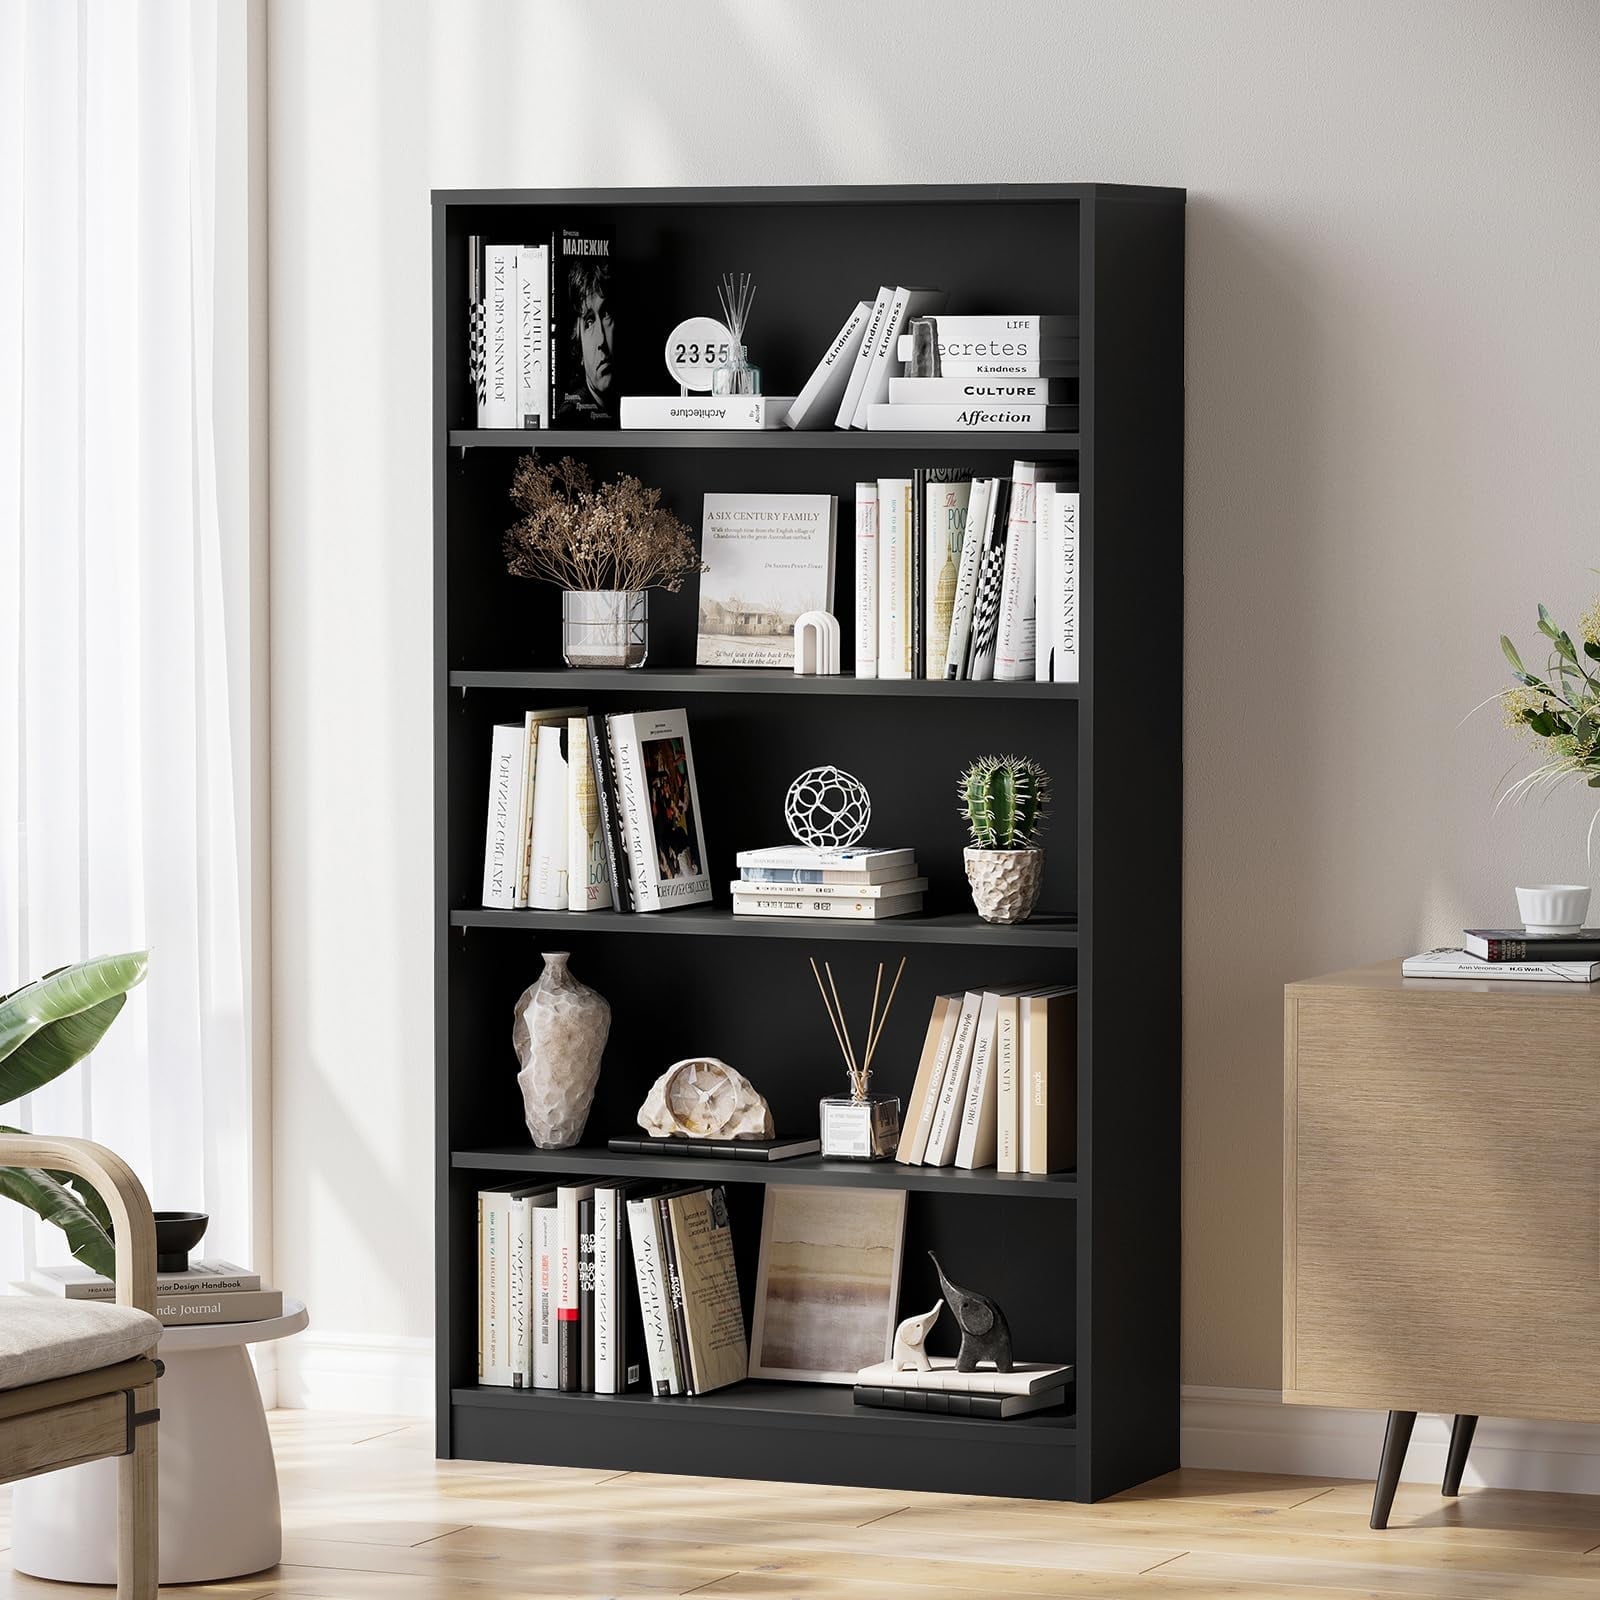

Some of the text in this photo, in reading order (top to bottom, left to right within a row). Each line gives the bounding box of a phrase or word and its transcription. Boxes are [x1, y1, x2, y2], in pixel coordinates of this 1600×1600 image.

[563, 238, 609, 256] МАЛЕЖИК
[492, 256, 505, 402] JOHANNES GRÜTZKE
[862, 302, 885, 358] Kindness
[878, 302, 902, 358] Kindness
[826, 316, 860, 366] Kindness
[938, 341, 1027, 356] ecretes
[676, 344, 700, 364] 23
[964, 386, 1036, 396] CULTURE
[670, 408, 726, 420] Architecture
[957, 410, 1032, 424] Affection
[708, 512, 820, 521] A SIX CENTURY FAMILY
[1062, 505, 1076, 654] JOHANNES GRÜTZKE
[1004, 1018, 1010, 1032] ON
[943, 1093, 951, 1104] for
[947, 1043, 964, 1085] sustainable
[958, 1013, 973, 1042] lifestyle
[965, 1094, 979, 1125] DREAM
[975, 1037, 989, 1068] AWAKE
[174, 1282, 200, 1291] Design
[202, 1280, 241, 1288] Handbook
[180, 1302, 220, 1316] Journal
